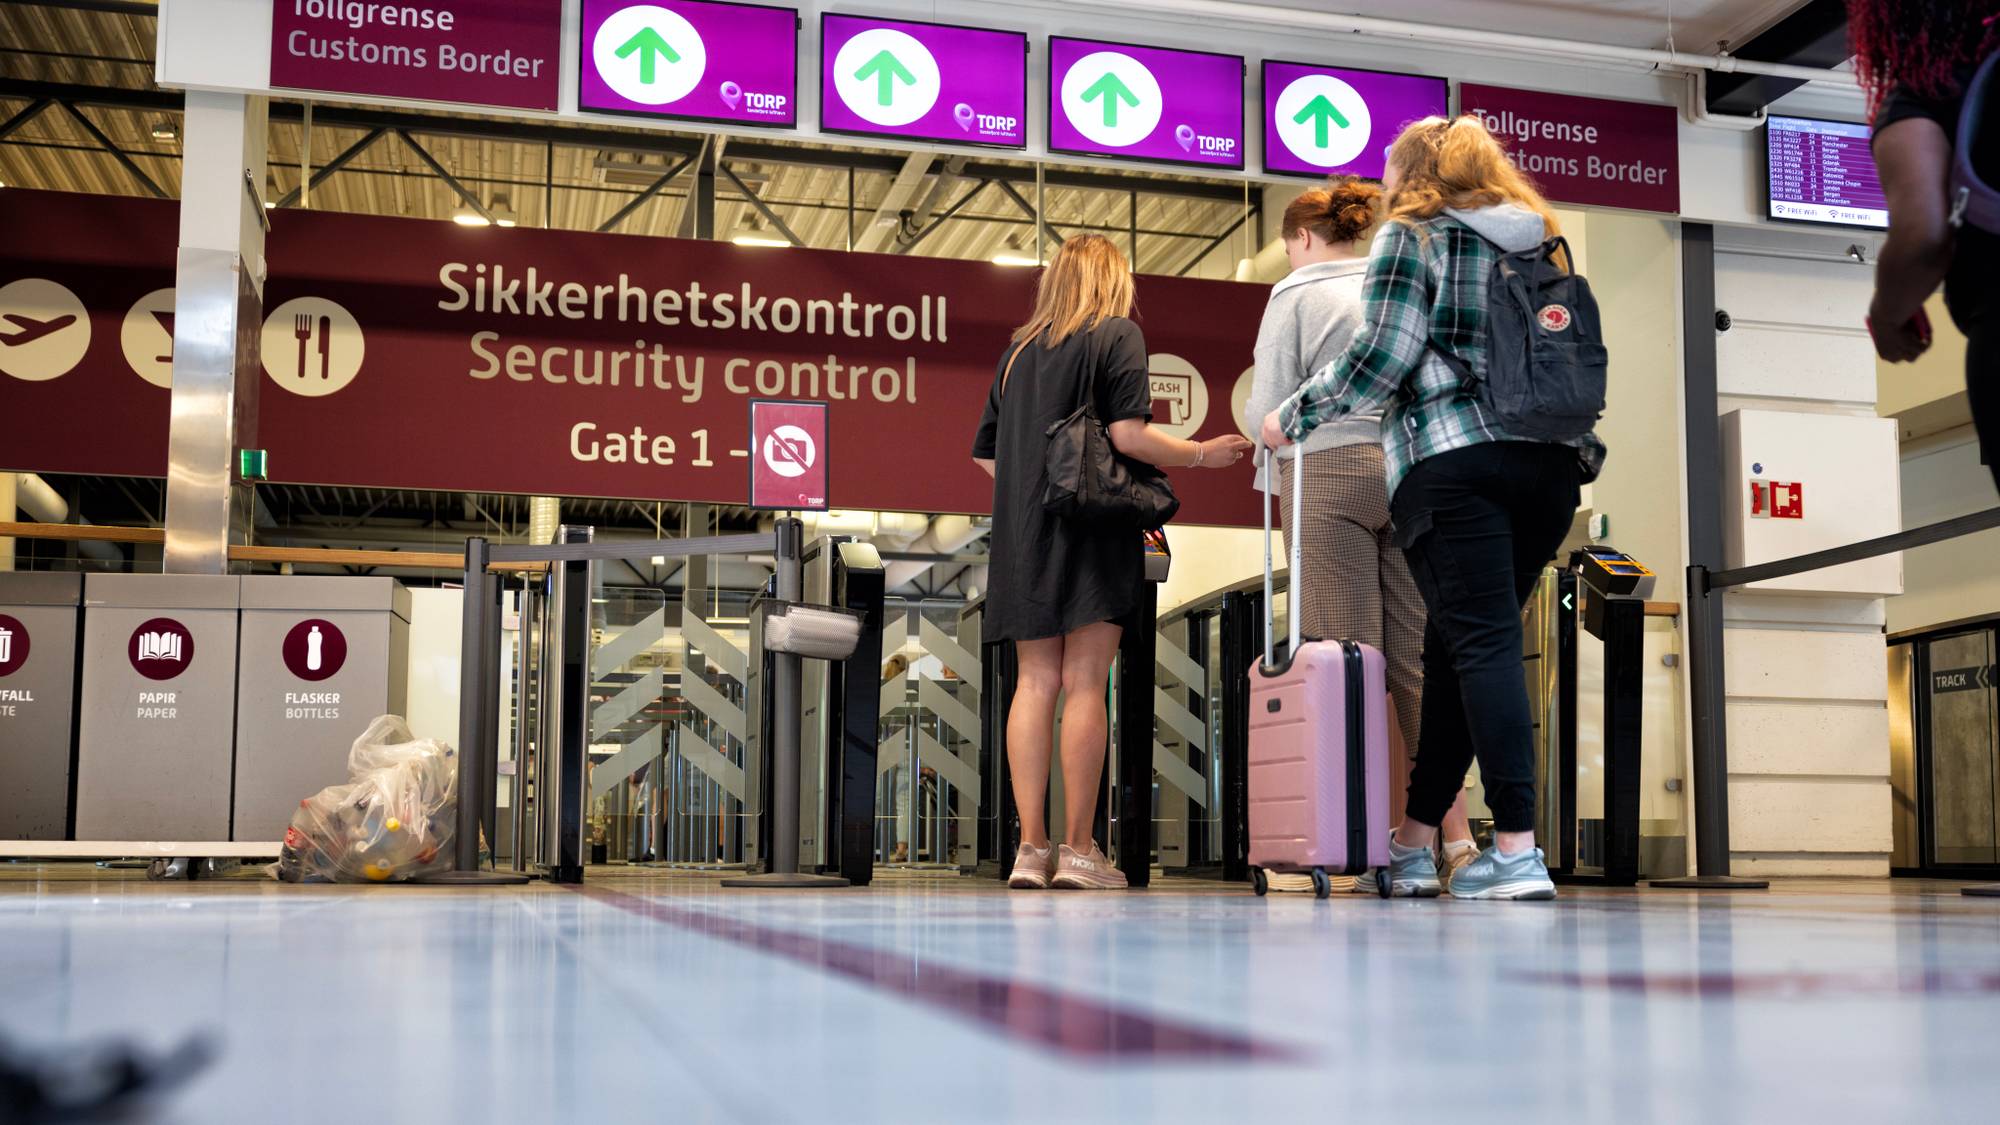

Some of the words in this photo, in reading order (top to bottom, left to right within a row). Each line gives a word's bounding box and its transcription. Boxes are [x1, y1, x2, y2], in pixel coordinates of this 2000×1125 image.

[288, 30, 428, 68] Customs
[438, 44, 544, 78] Border
[744, 92, 786, 110] TORP
[976, 114, 1016, 131] TORP
[1197, 135, 1235, 152] TORP
[1506, 148, 1579, 176] stoms
[1587, 156, 1668, 185] Border
[438, 262, 948, 342] Sikkerhetskontroll
[469, 331, 704, 403] Security
[724, 354, 917, 404] control
[1151, 382, 1180, 393] CASH
[570, 422, 676, 466] Gate
[691, 429, 714, 467] 1
[1936, 674, 1966, 688] TRACK
[139, 692, 176, 704] PAPIR
[285, 692, 340, 704] FLASKER
[137, 708, 177, 719] PAPER
[286, 708, 340, 719] BOTTLES
